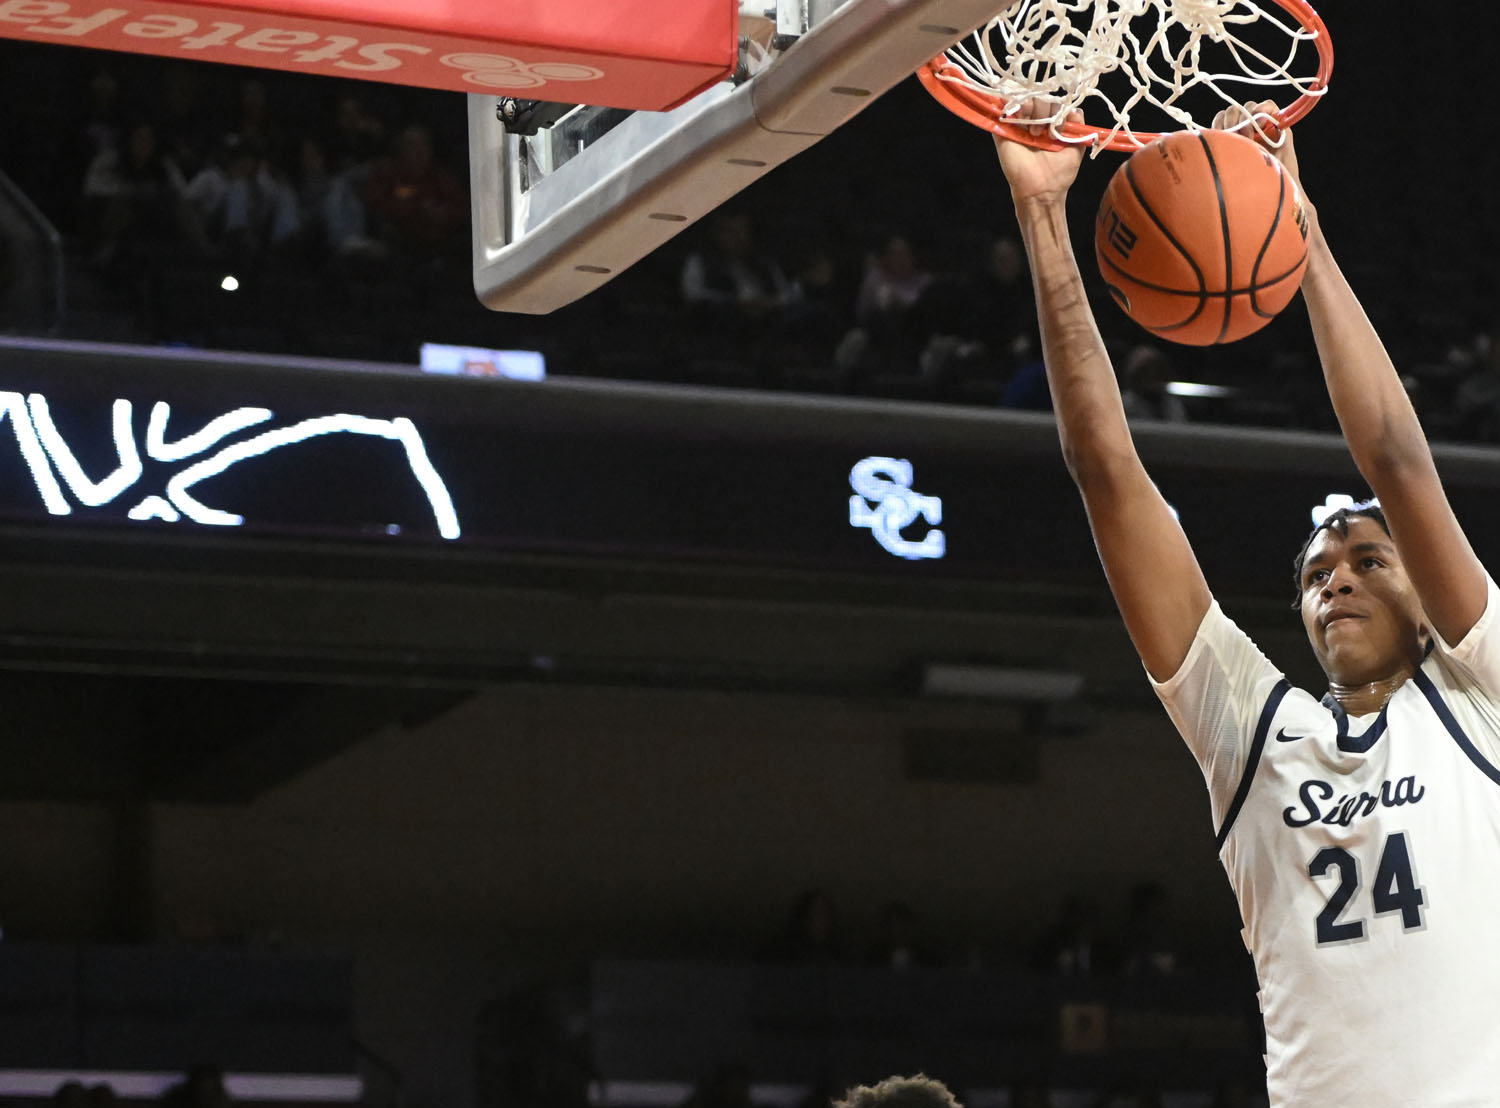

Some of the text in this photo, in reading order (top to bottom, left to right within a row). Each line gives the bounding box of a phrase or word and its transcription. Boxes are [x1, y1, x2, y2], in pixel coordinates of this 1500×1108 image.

[122, 13, 431, 72] State
[850, 456, 946, 560] SC
[1307, 829, 1430, 949] 24
